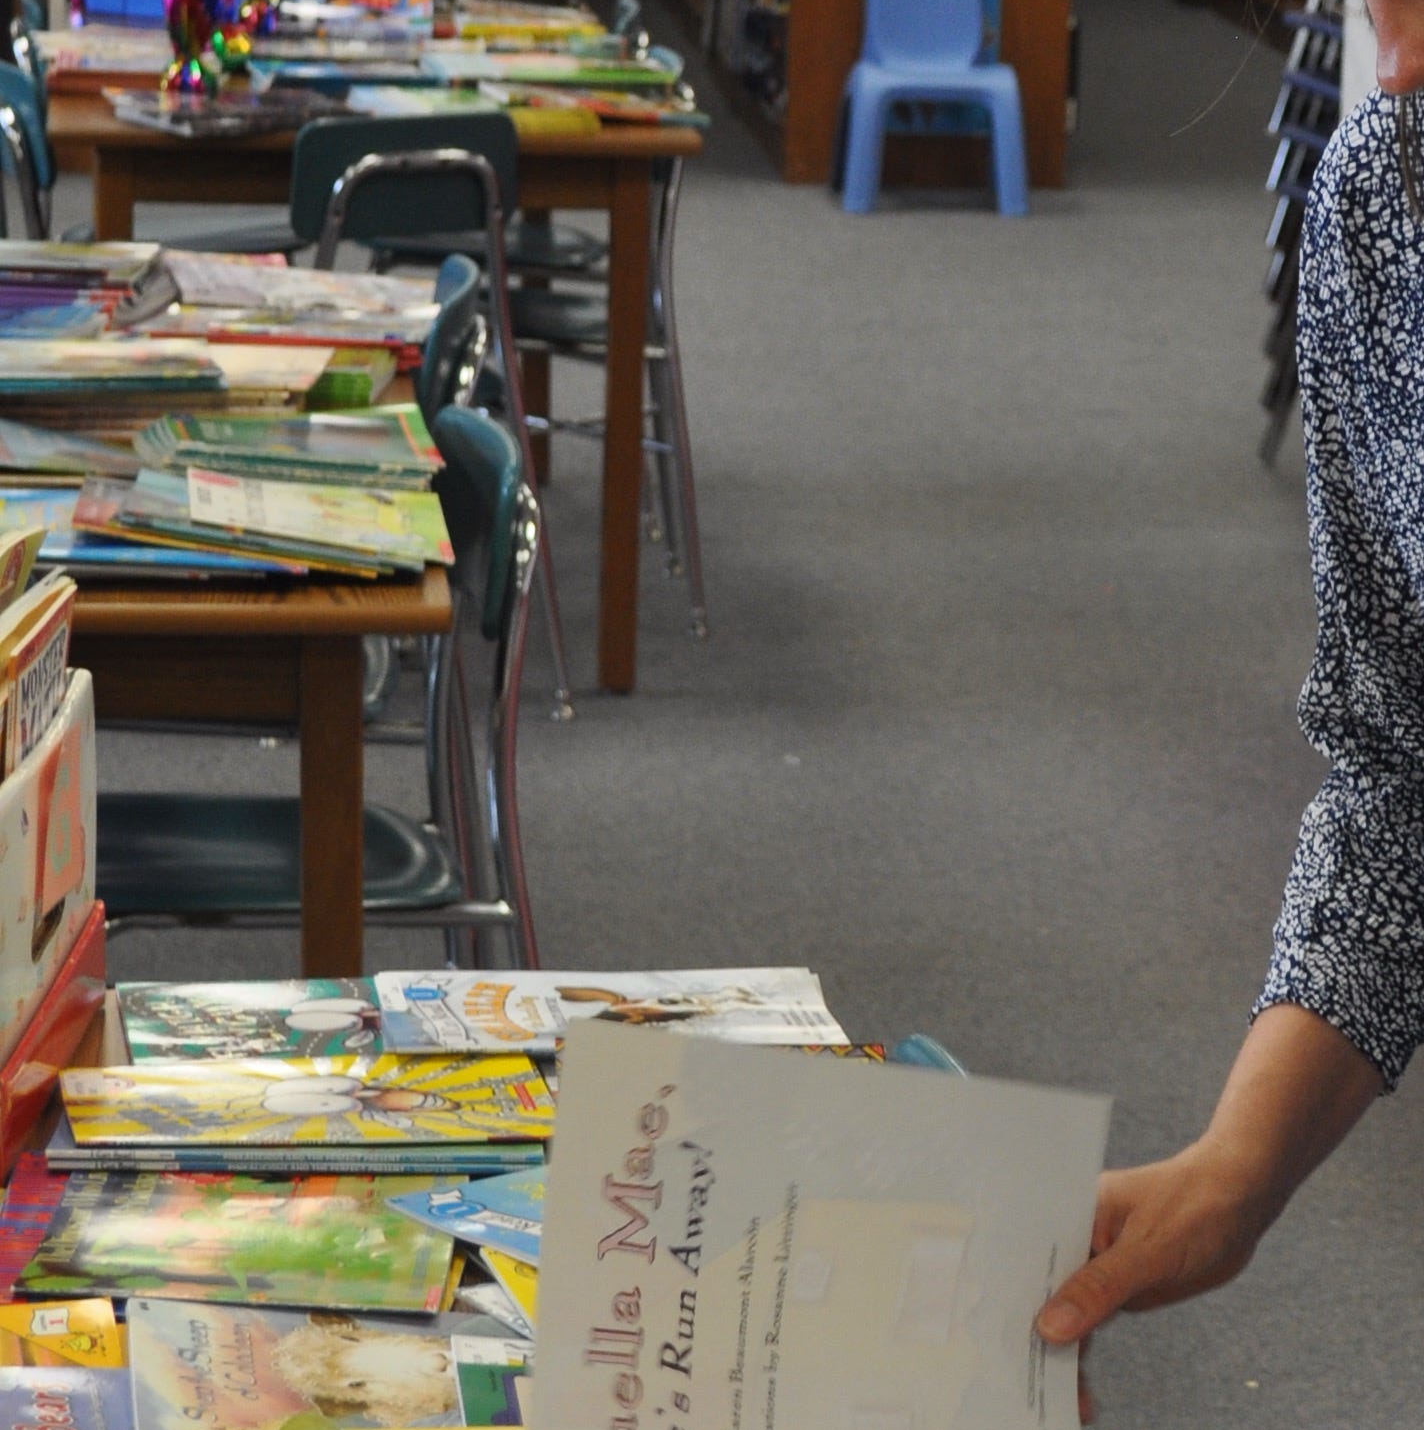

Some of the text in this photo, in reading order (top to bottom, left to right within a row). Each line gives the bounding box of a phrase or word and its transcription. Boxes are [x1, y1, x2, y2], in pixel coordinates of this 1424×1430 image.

[597, 1083, 678, 1265] Mae,
[667, 1140, 718, 1279] Away!
[658, 1288, 699, 1382] Run
[728, 1289, 751, 1383] Beaumont
[763, 1350, 781, 1373] by
